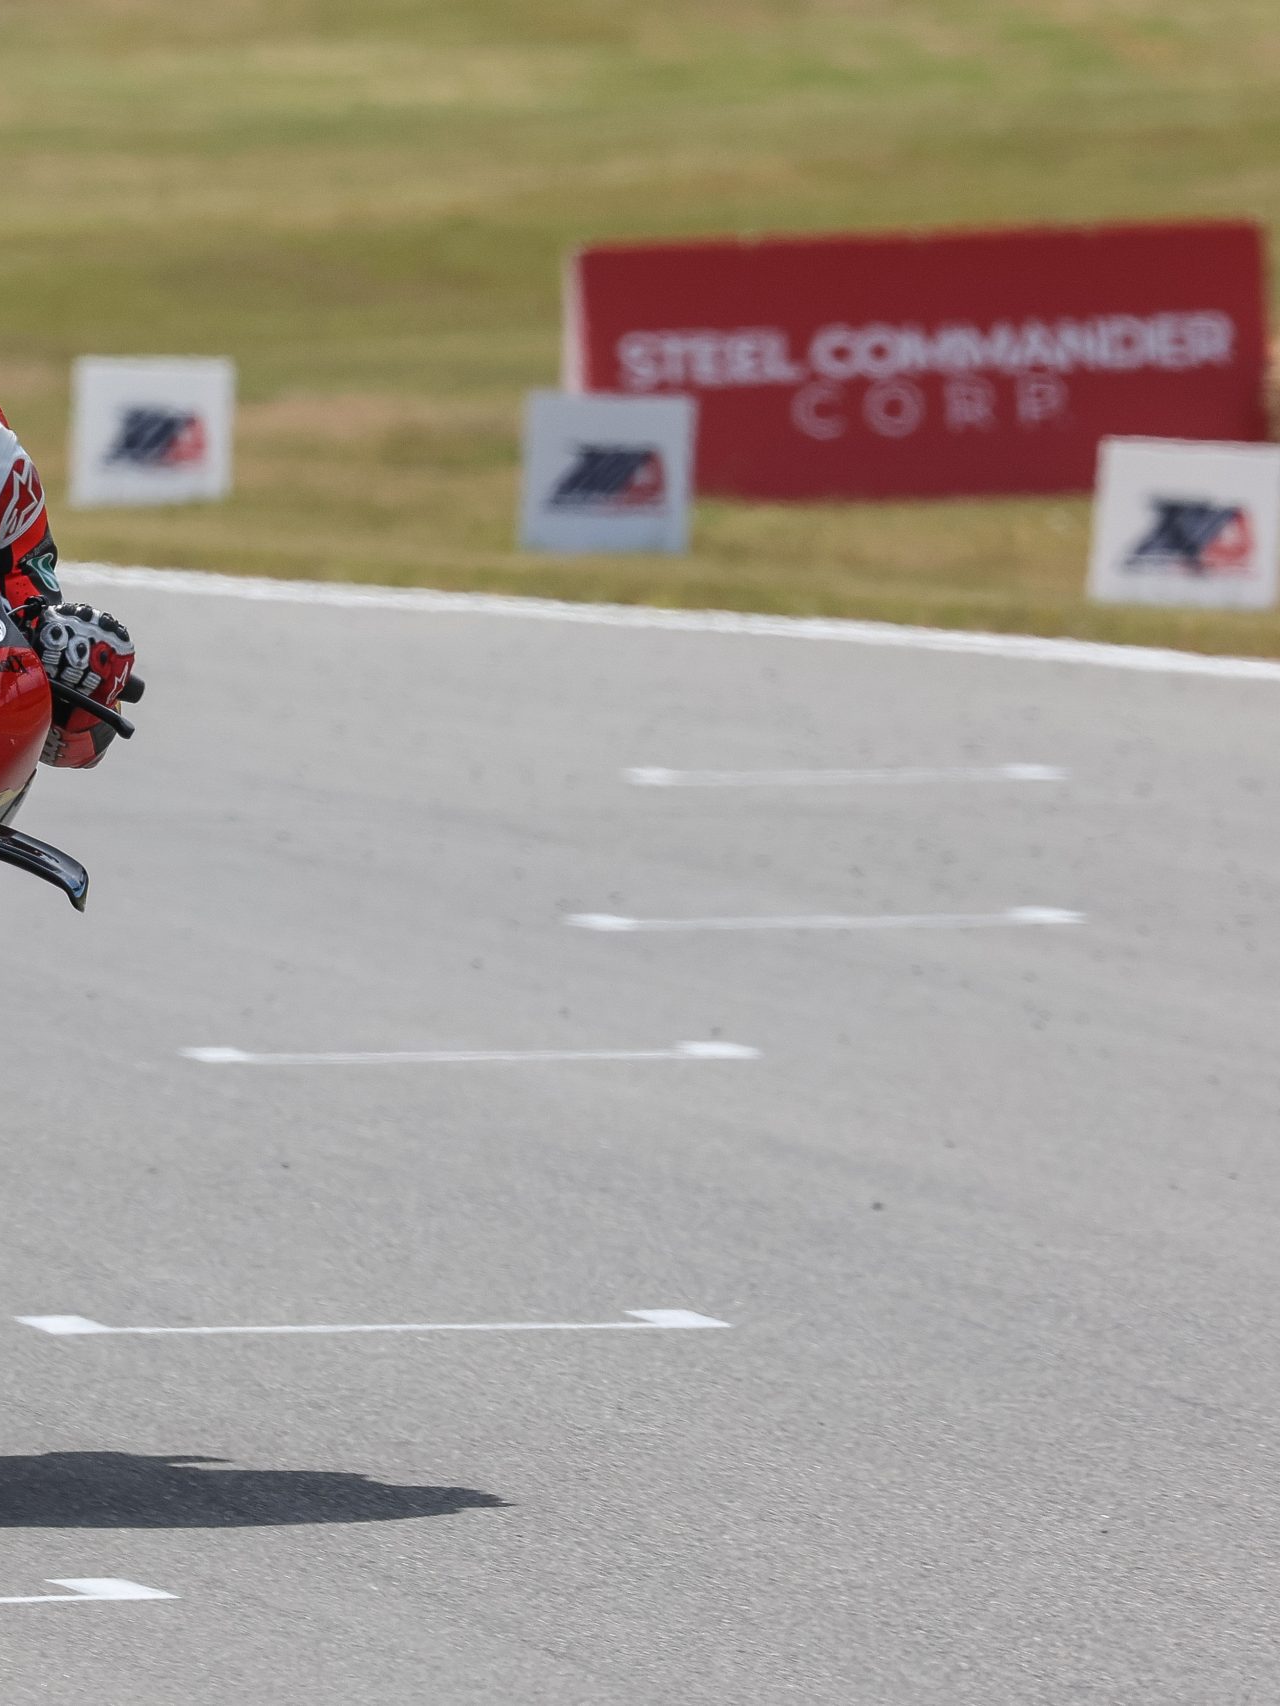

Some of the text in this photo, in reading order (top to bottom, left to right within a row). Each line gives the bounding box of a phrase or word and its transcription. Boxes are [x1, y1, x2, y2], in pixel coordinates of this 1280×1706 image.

[618, 309, 1238, 390] STEEL COMMANDER
[791, 371, 1070, 440] CORP
